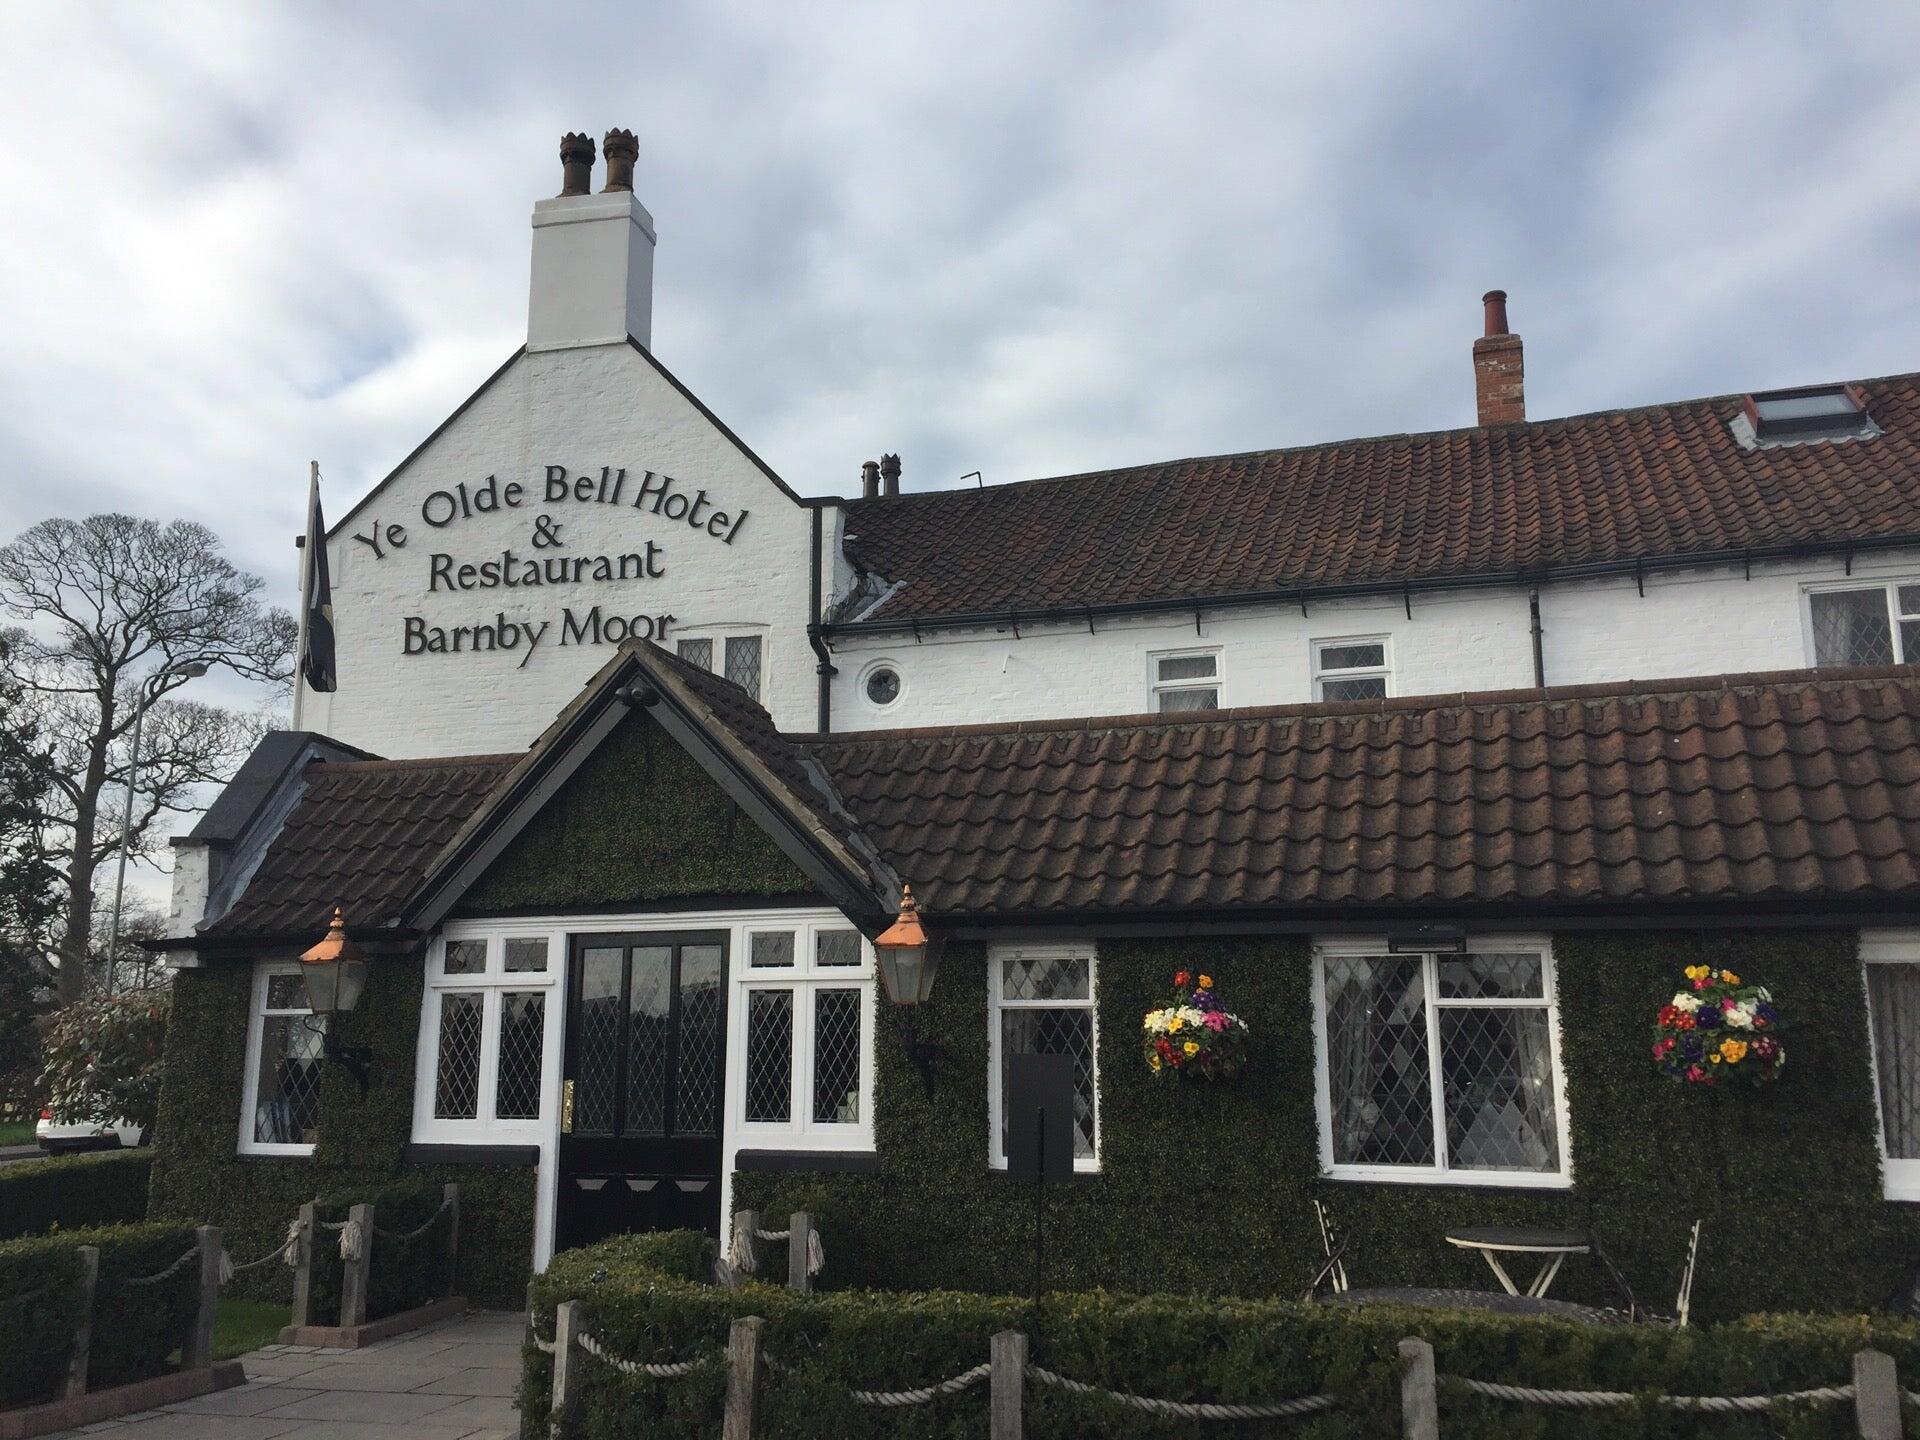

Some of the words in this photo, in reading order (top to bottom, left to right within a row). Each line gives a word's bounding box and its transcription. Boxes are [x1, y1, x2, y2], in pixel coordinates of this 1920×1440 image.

[352, 520, 407, 560] Ye
[422, 474, 523, 527] Olde
[544, 465, 626, 504] Bell
[633, 471, 749, 545] Hotel
[531, 514, 563, 548] &
[428, 540, 665, 592] Restaurant
[402, 612, 550, 669] Barnby
[558, 606, 677, 645] Moor
